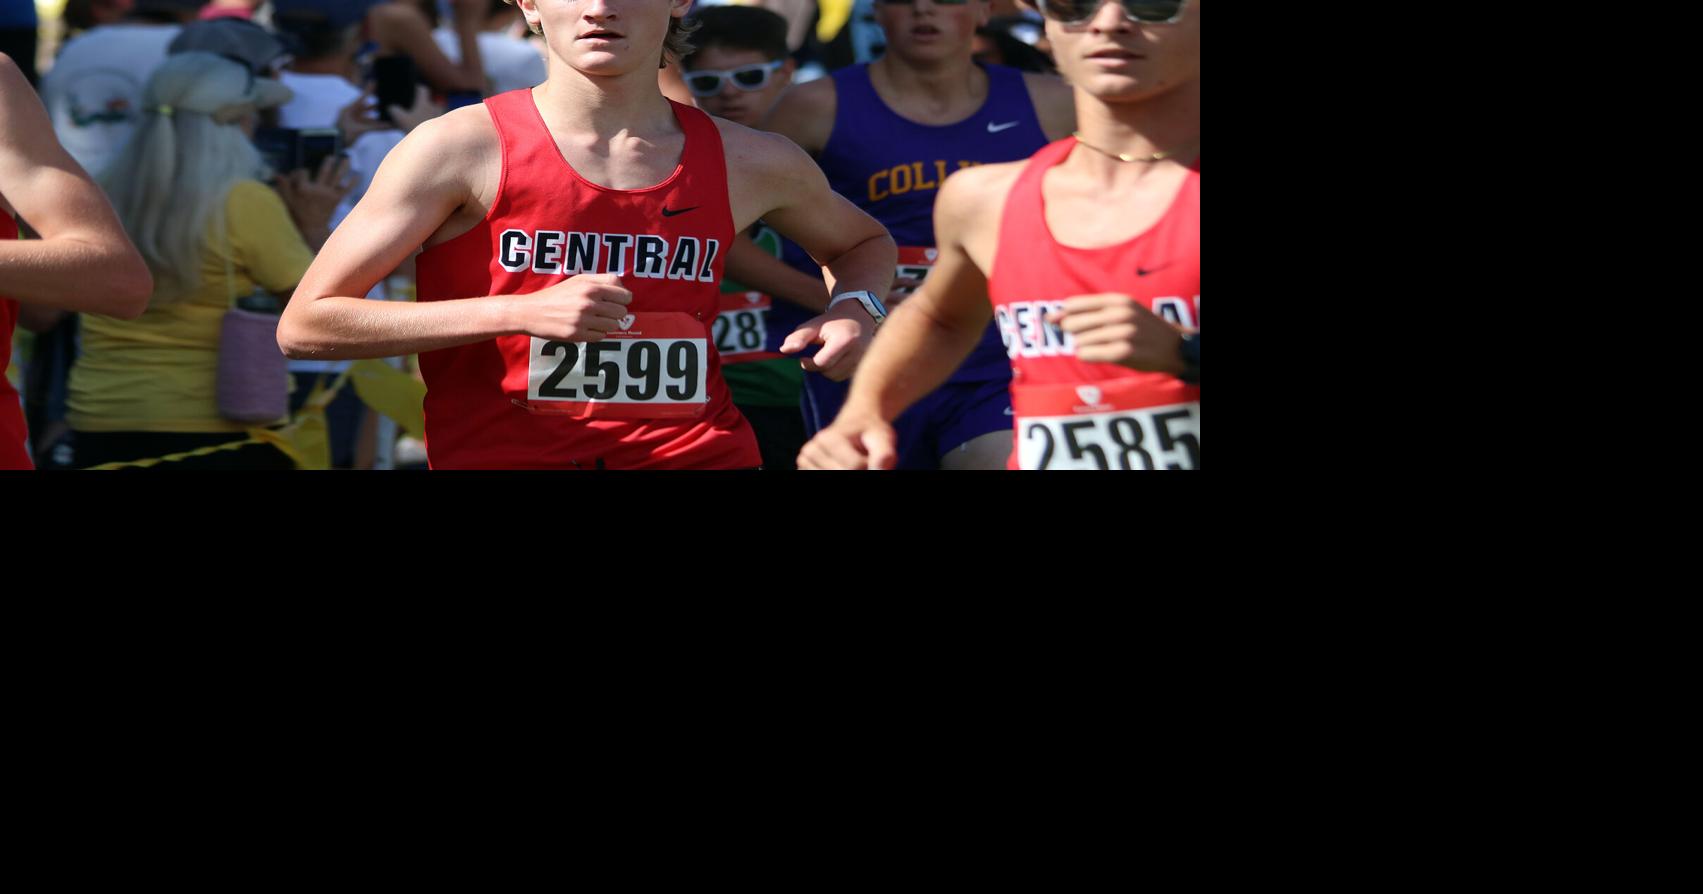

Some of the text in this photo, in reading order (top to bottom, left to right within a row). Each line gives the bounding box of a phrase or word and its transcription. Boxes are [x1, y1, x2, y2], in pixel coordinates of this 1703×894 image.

[868, 160, 983, 202] COLL
[498, 228, 719, 283] CENTRAL
[712, 311, 767, 352] 28
[995, 295, 1200, 360] CENA
[538, 340, 699, 401] 2599
[1027, 409, 1200, 471] 2585
